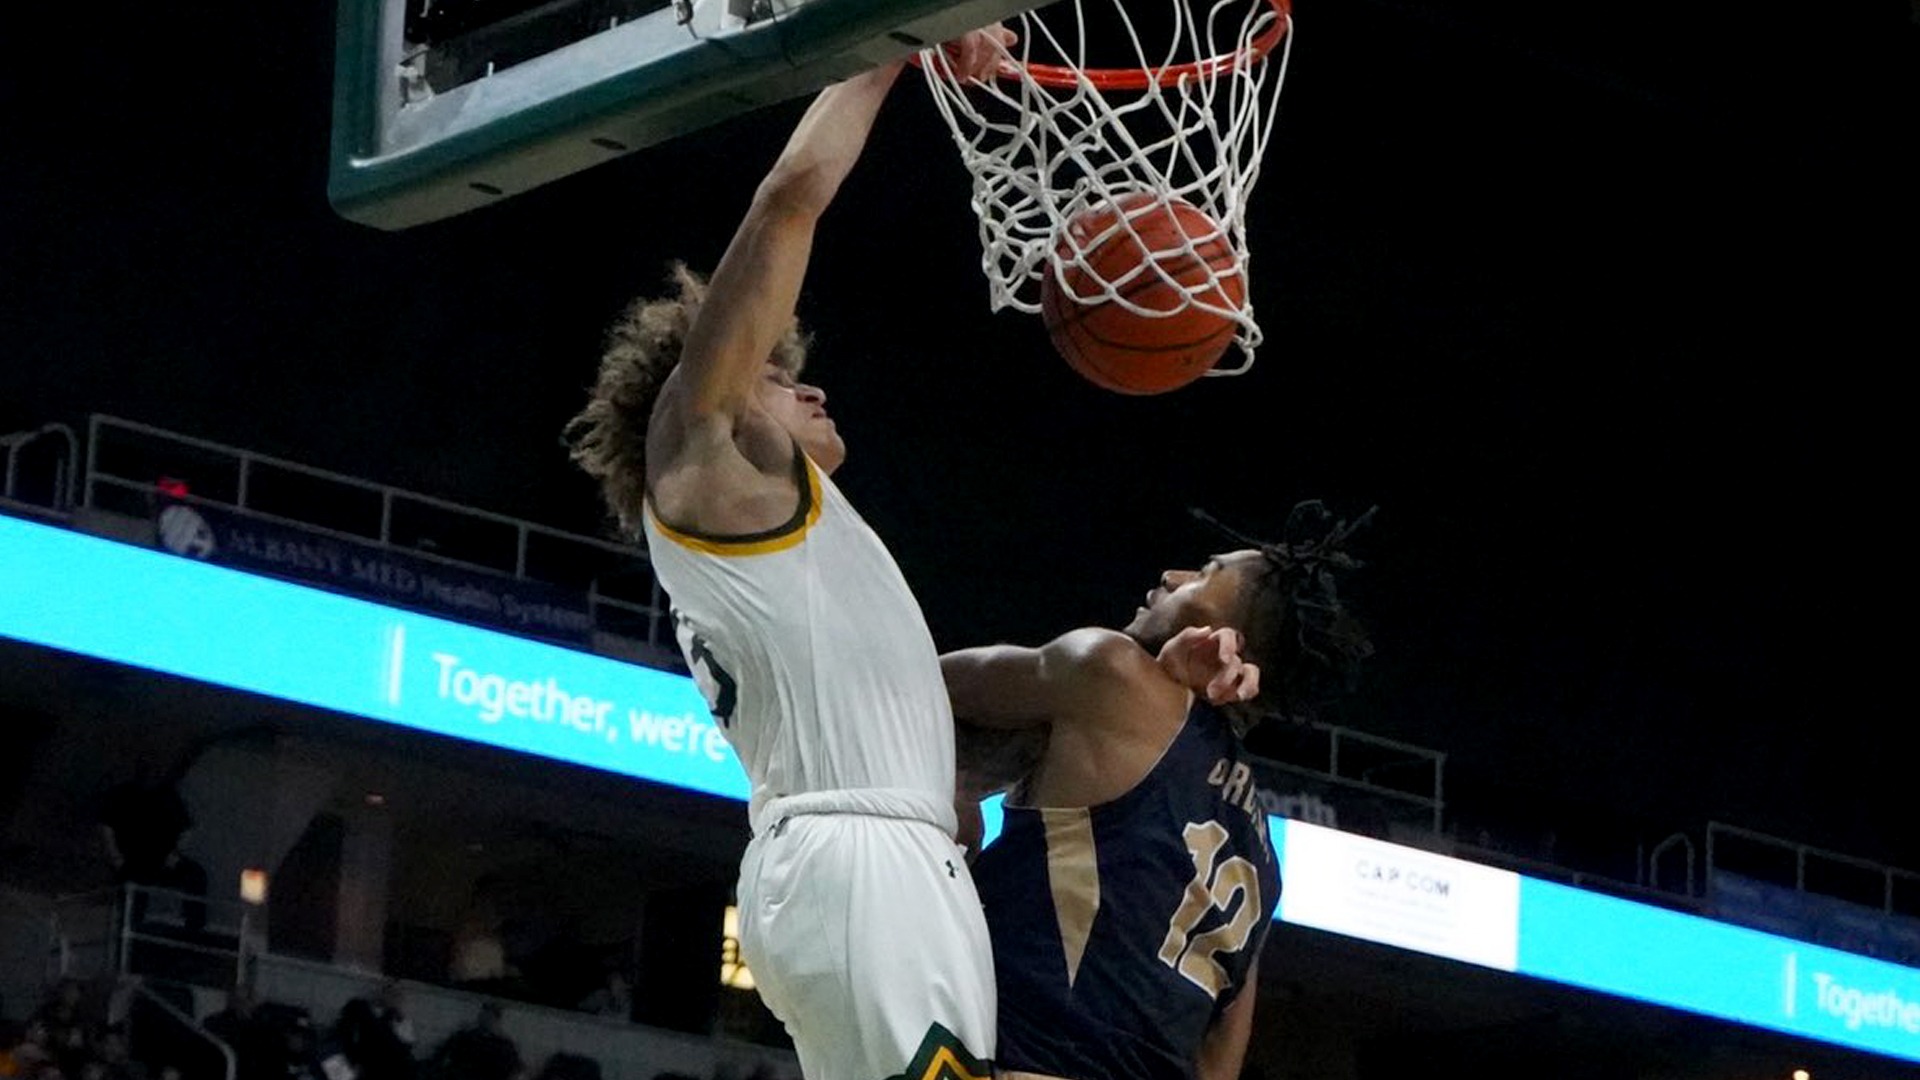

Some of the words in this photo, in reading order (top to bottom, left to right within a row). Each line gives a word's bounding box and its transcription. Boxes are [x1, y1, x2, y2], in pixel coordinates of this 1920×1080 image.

[353, 558, 418, 593] MED
[430, 651, 618, 744] Together,
[629, 708, 727, 762] we're
[1158, 820, 1261, 1001] 12
